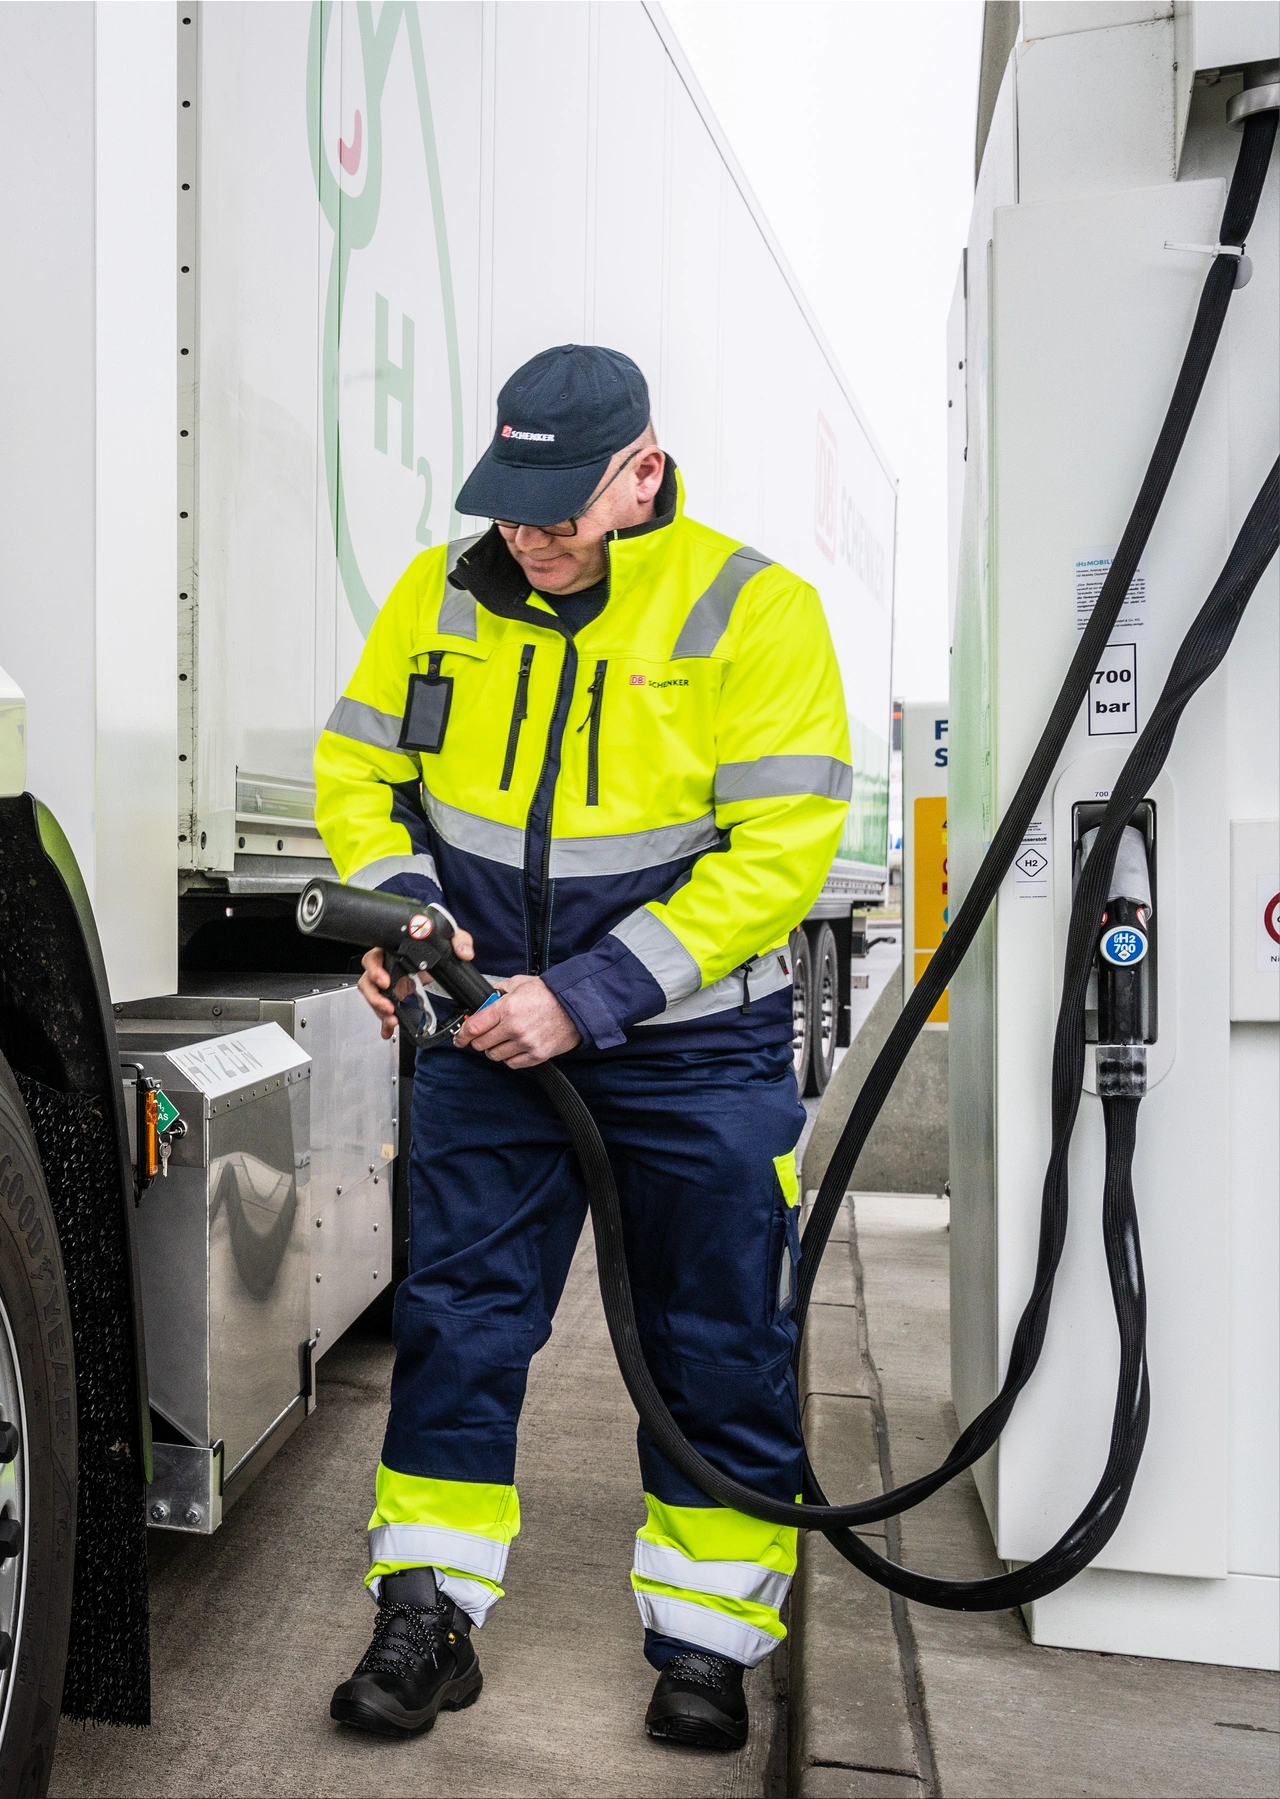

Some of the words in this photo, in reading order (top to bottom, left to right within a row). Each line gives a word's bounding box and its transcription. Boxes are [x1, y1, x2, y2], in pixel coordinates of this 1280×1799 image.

[511, 430, 555, 442] SCHENKER
[631, 676, 644, 684] DB
[648, 679, 689, 688] SCHENKER
[1094, 669, 1131, 684] 700
[1095, 700, 1131, 714] bar
[935, 719, 948, 740] F
[934, 747, 948, 767] S
[1025, 859, 1038, 867] H2
[1119, 932, 1136, 943] H2
[1114, 943, 1136, 953] 700
